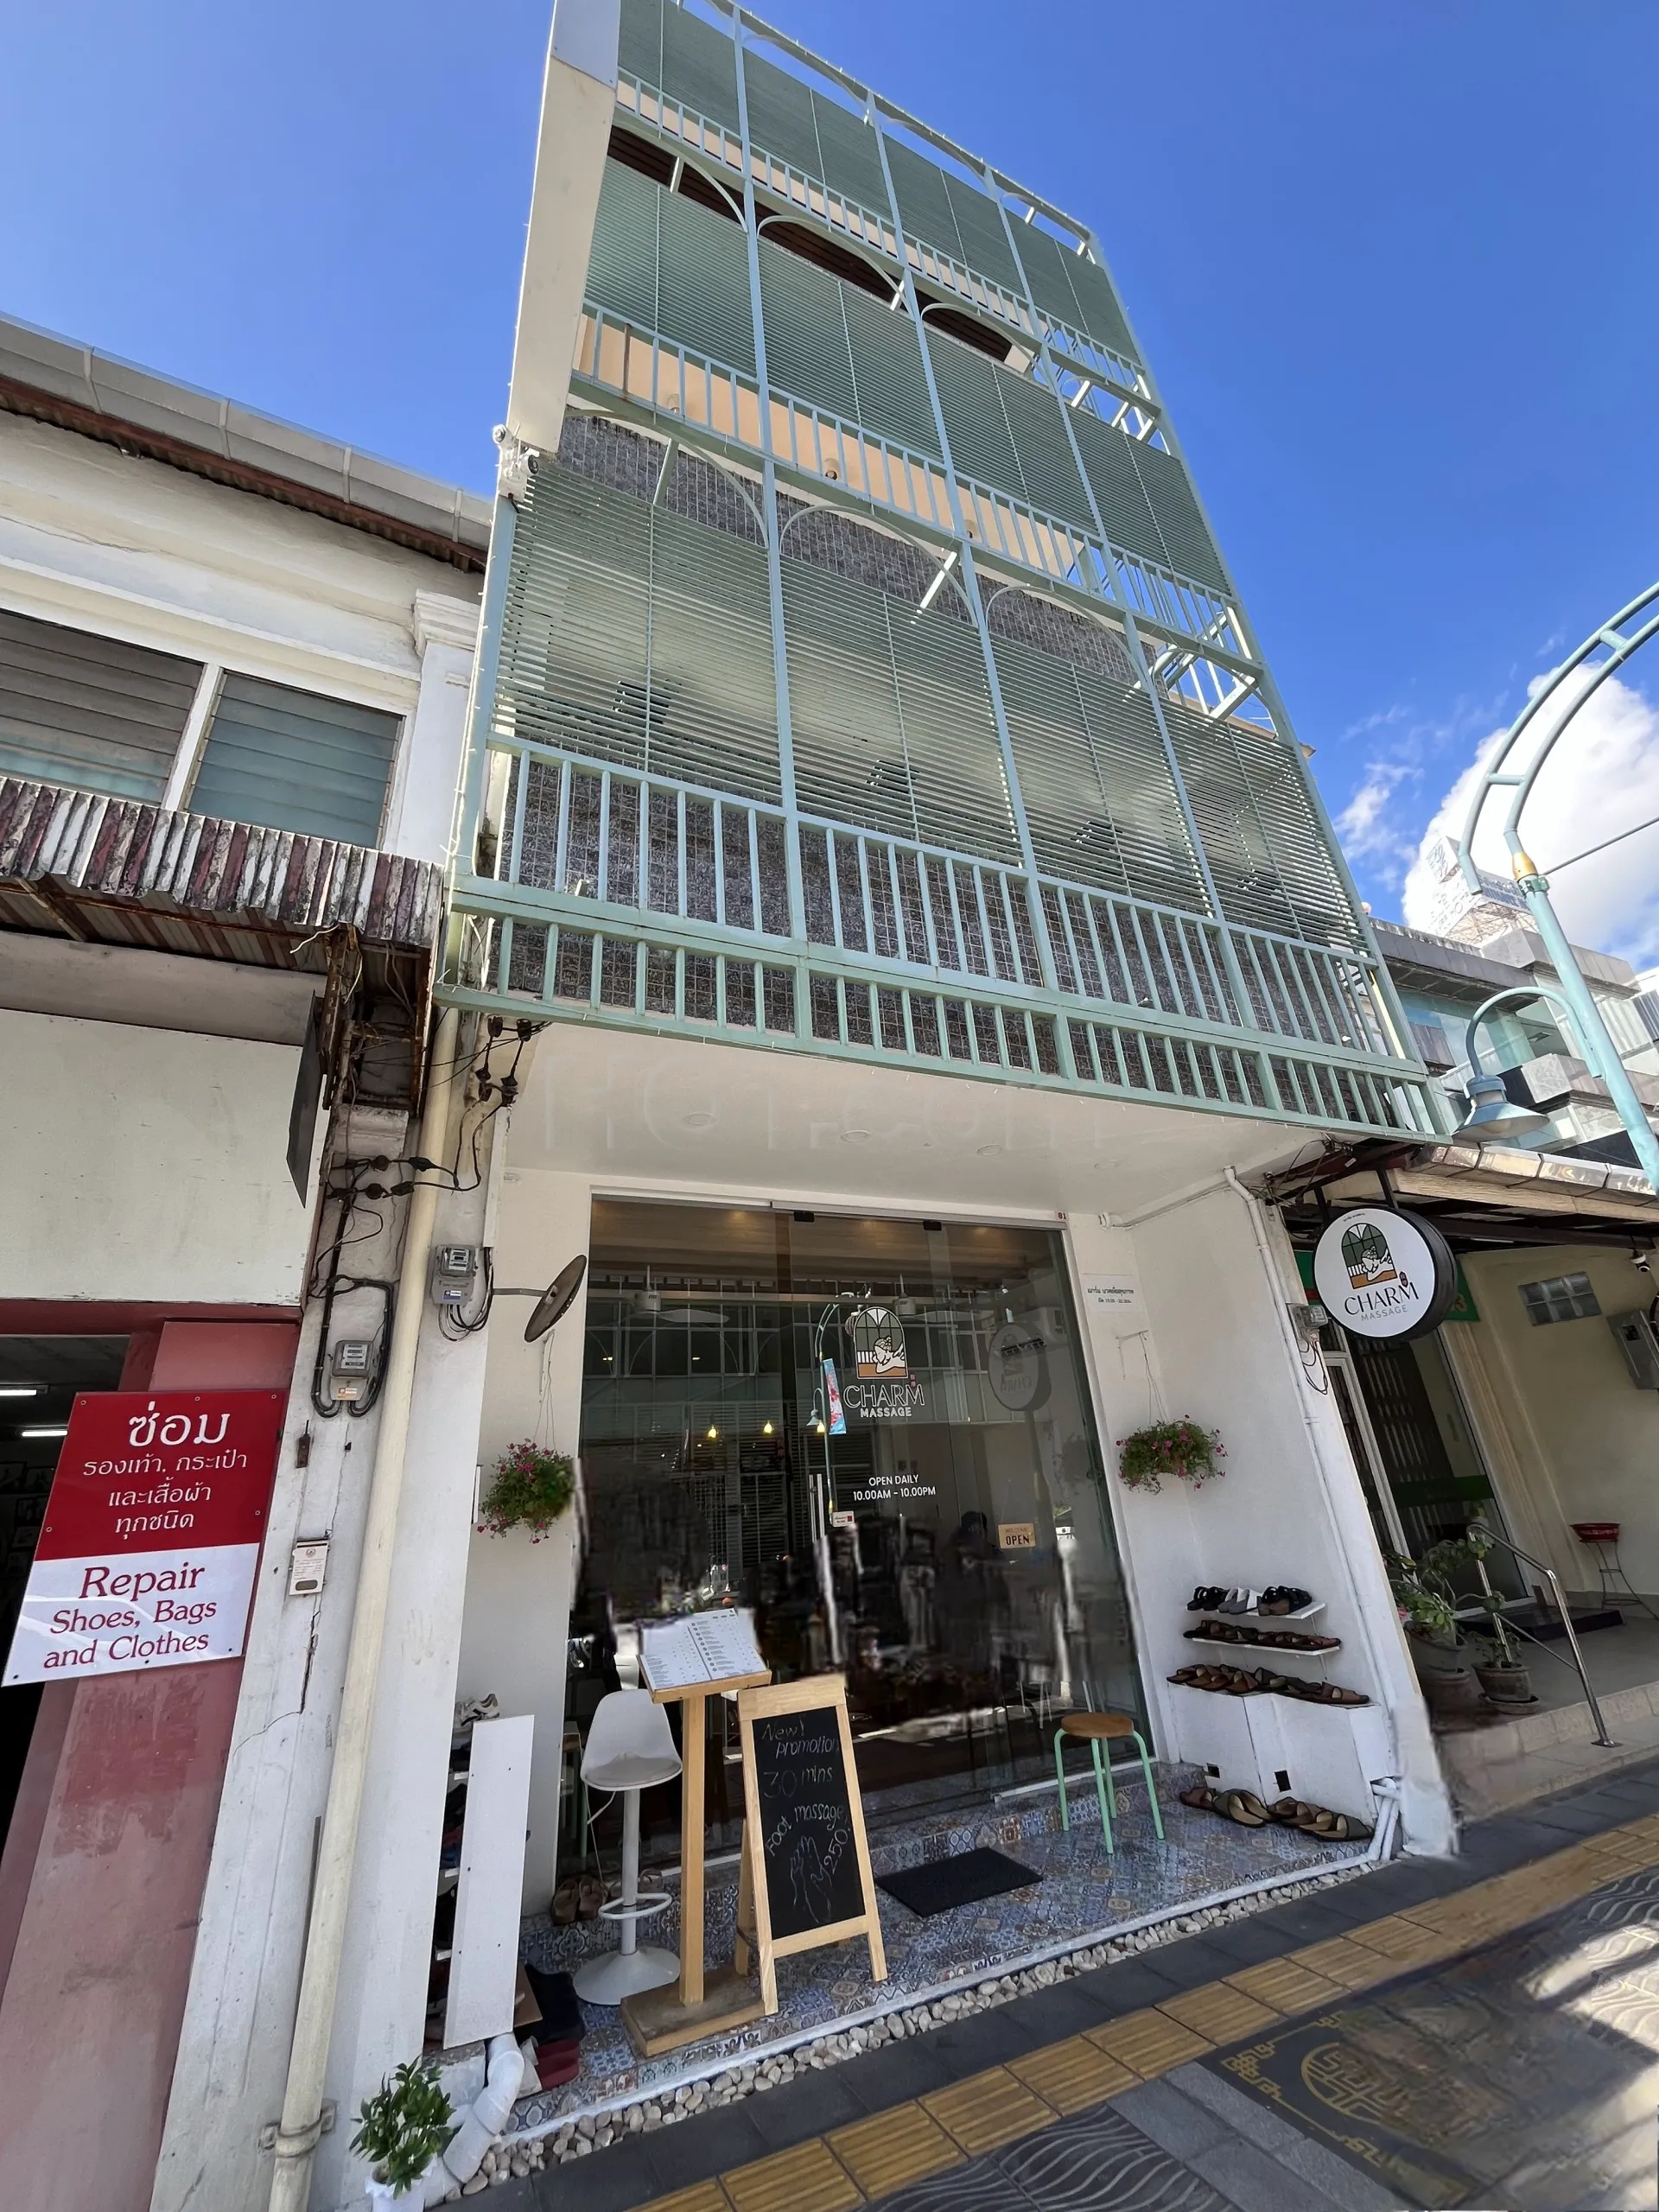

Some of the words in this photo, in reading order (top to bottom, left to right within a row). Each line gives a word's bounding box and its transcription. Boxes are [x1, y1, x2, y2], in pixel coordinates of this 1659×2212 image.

[1344, 1281, 1420, 1315] CHARM
[1361, 1305, 1408, 1321] MASSAGE
[843, 1384, 925, 1408] CHARM
[129, 1401, 231, 1446] ซ่อม
[860, 1407, 912, 1418] MASSAGE
[175, 1448, 248, 1471] กระเป๋า
[108, 1476, 212, 1507] และเสื้อผ้า
[853, 1489, 892, 1501] 10.00AM
[899, 1486, 936, 1497] 10.00PM
[868, 1476, 893, 1486] OPEN
[894, 1474, 919, 1484] DAILY
[115, 1510, 194, 1541] ทุกชนิด
[1006, 1535, 1030, 1546] OPEN
[79, 1561, 206, 1602] Repair
[50, 1608, 141, 1634] Shoes,
[153, 1599, 217, 1625] Bags
[43, 1639, 99, 1669] and
[108, 1630, 209, 1661] Clothes
[763, 1769, 798, 1798] 30
[801, 1764, 833, 1785] mins
